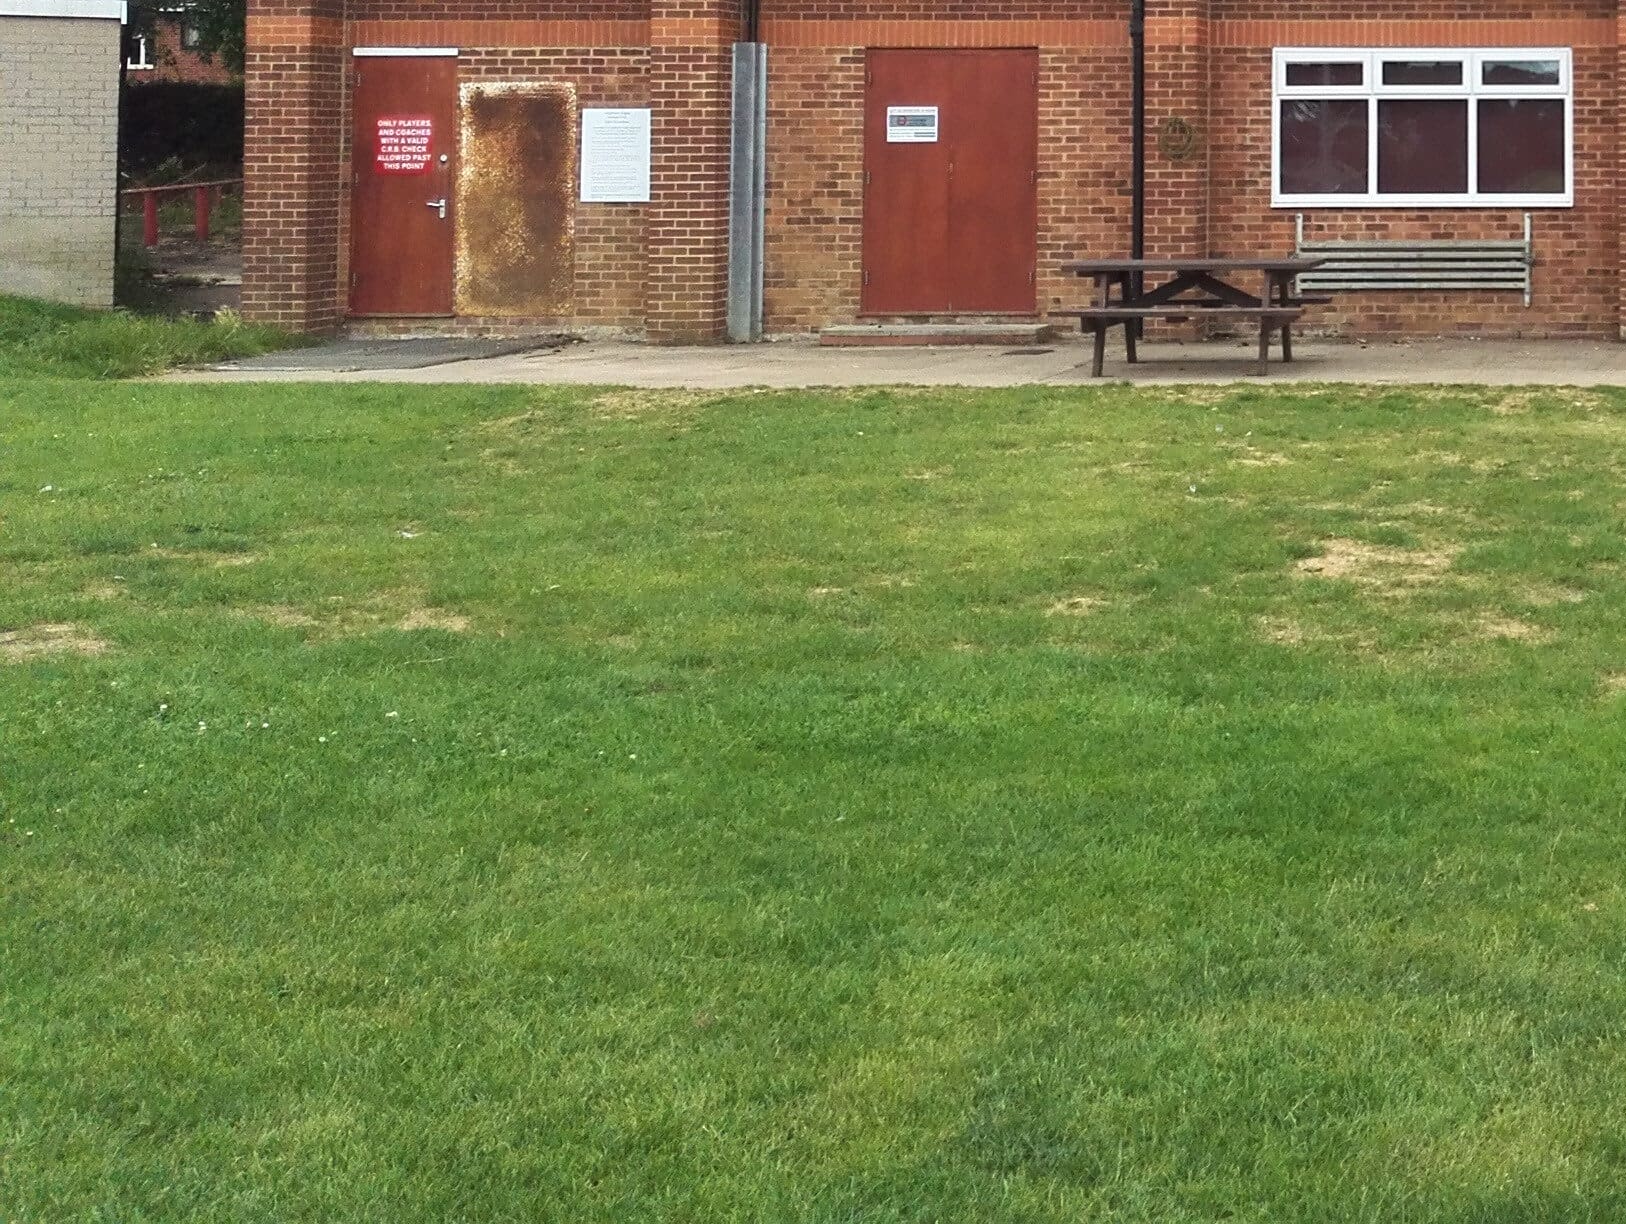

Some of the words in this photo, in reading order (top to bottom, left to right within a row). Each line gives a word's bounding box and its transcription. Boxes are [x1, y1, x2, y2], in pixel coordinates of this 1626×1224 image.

[377, 119, 397, 127] ONLY
[378, 128, 394, 136] AND
[395, 128, 432, 136] COACHES
[401, 145, 427, 153] CHECK
[384, 162, 400, 170] THIS
[401, 162, 424, 170] POINT
